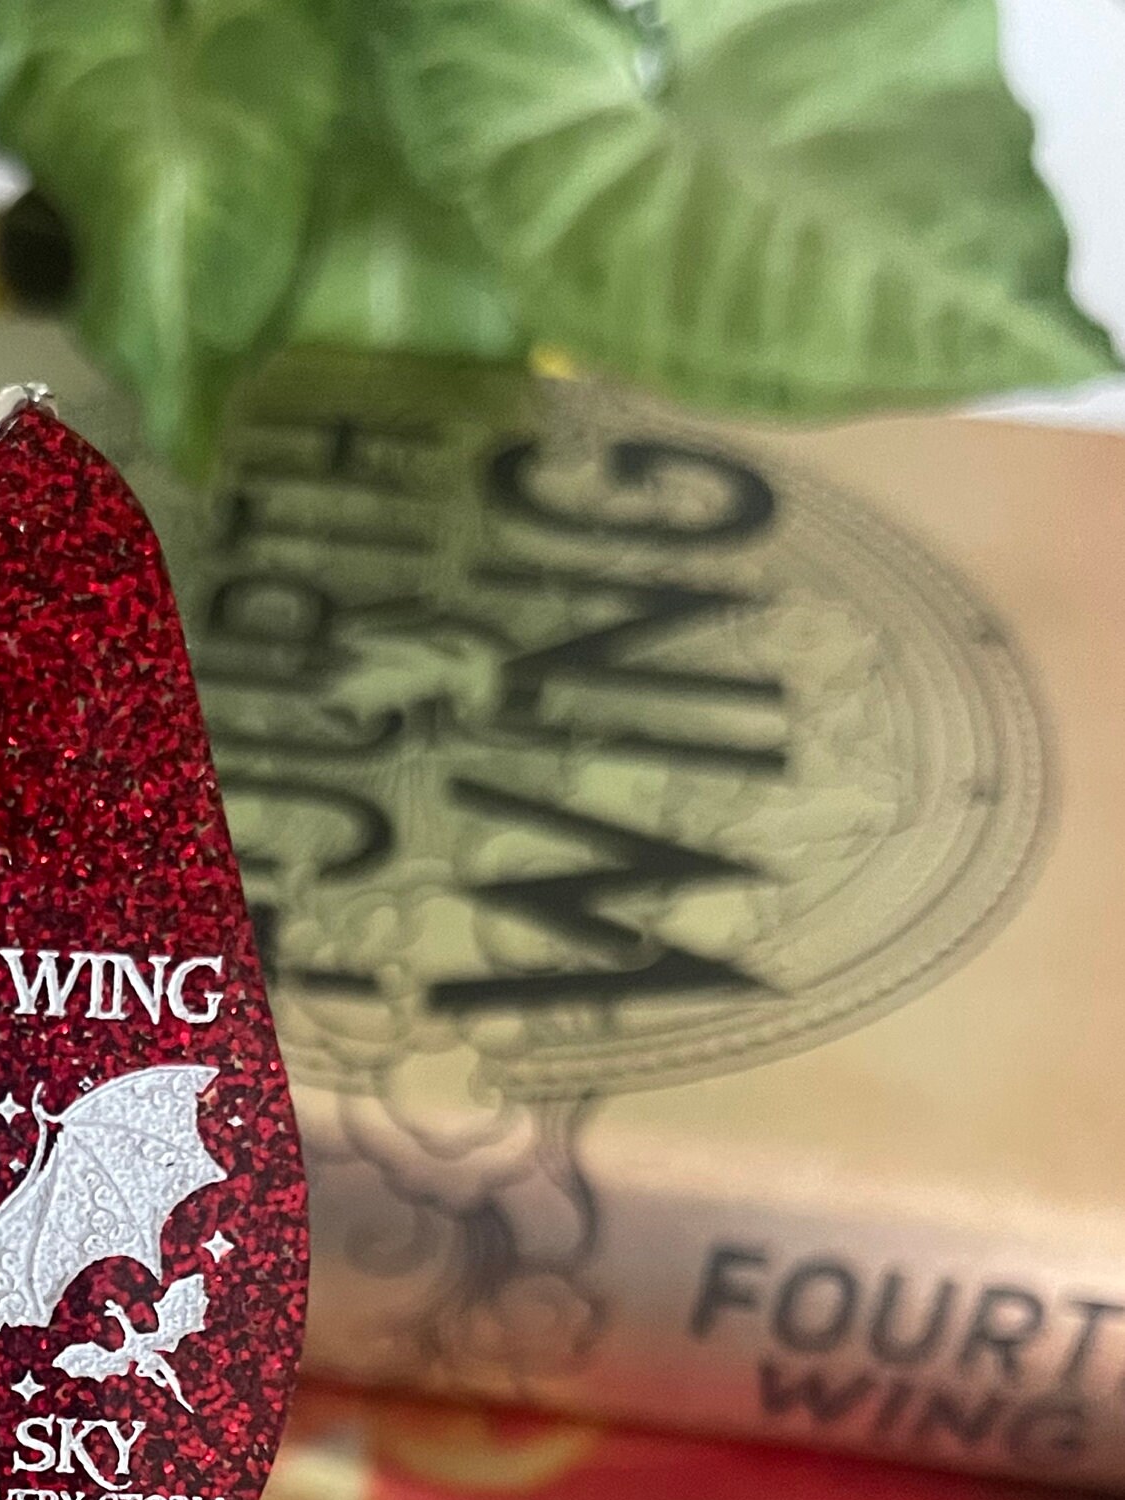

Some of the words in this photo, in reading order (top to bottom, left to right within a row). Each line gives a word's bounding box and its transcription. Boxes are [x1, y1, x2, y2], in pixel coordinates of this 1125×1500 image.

[426, 438, 790, 1020] WING
[687, 1240, 1125, 1400] FOURT
[11, 1413, 147, 1492] SKY
[757, 1355, 1089, 1464] WING
